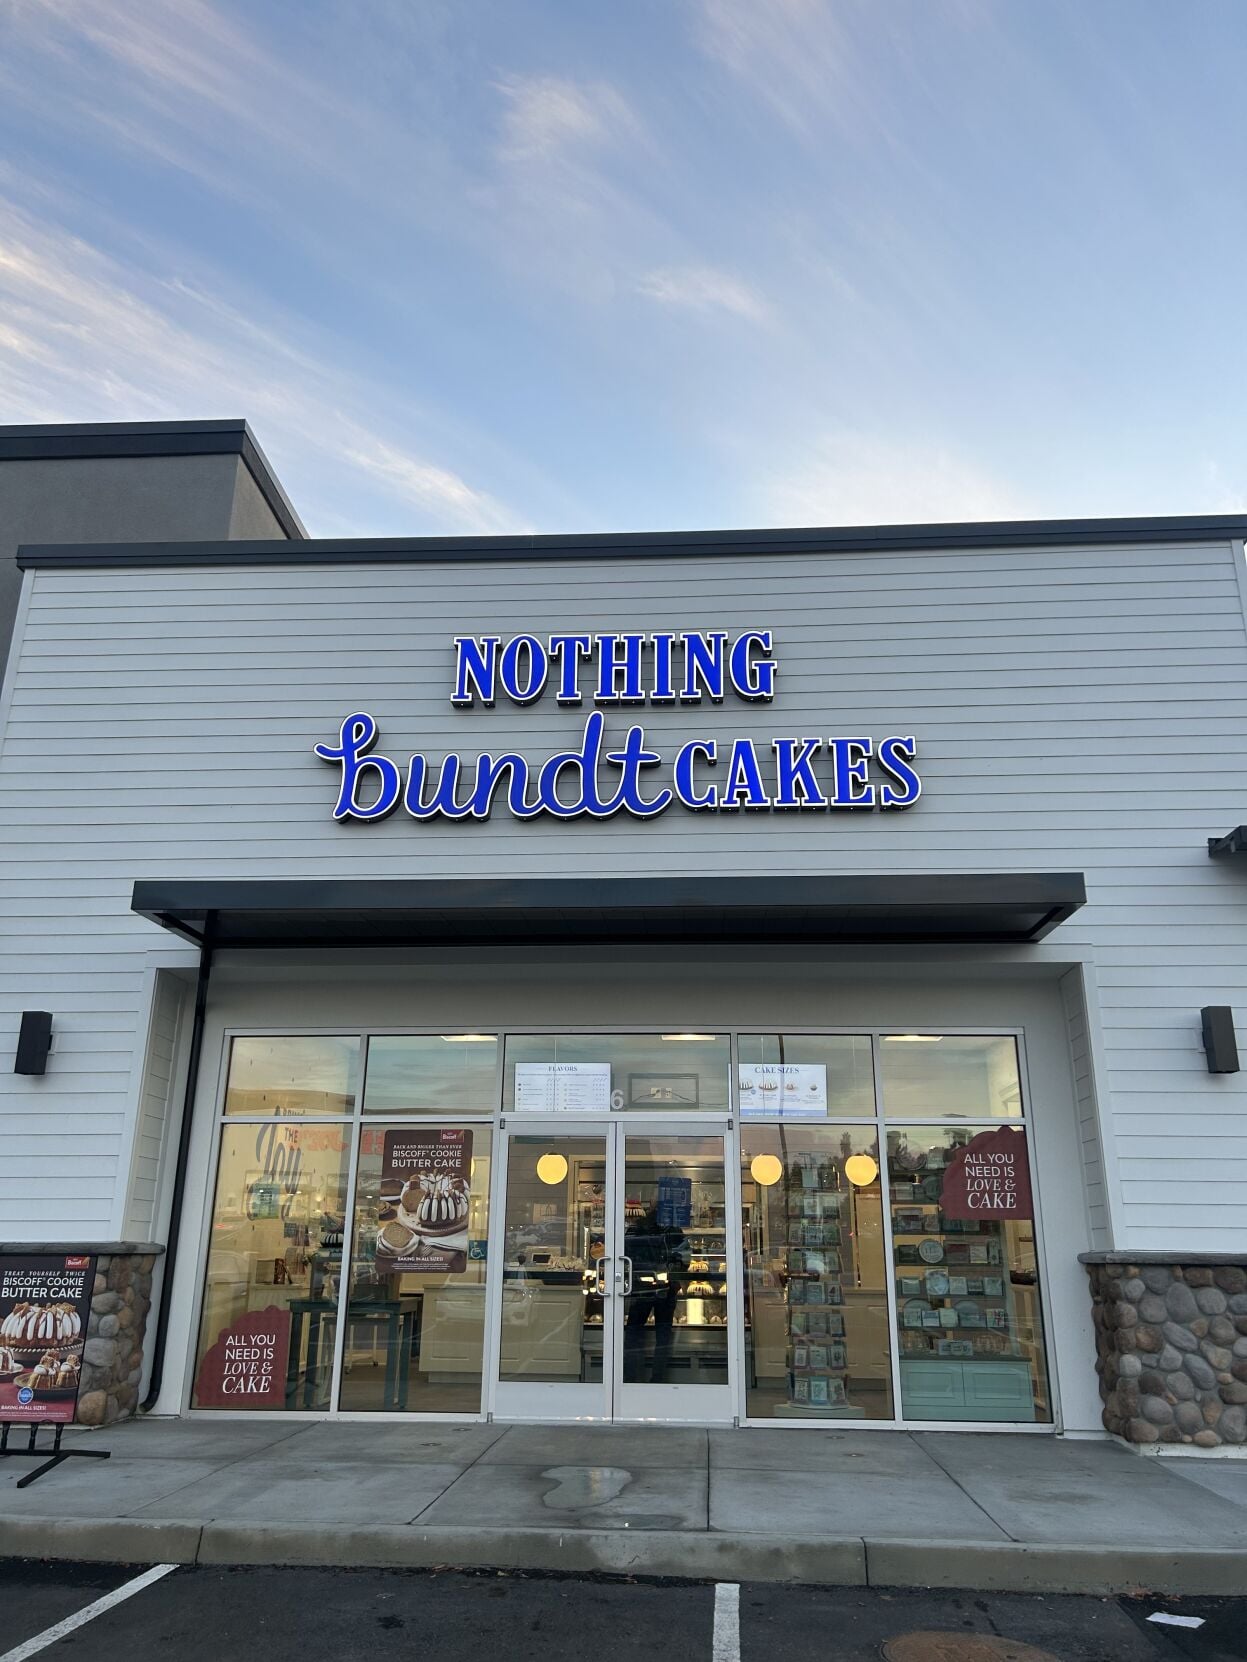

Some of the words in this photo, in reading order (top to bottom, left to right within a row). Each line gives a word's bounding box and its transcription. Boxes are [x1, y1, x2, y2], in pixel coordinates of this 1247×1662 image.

[450, 630, 778, 704] NOTHING
[314, 710, 672, 821] bundt
[673, 735, 923, 809] CAKES
[754, 1066, 776, 1074] CAKE
[777, 1066, 800, 1074] SIZES
[610, 1089, 624, 1110] 6
[284, 1126, 299, 1143] THE
[391, 1159, 431, 1168] BUTTER
[434, 1159, 462, 1168] CAKE
[964, 1153, 986, 1164] ALL
[987, 1153, 1014, 1164] YOU
[965, 1166, 1001, 1177] NEED
[1004, 1166, 1015, 1177] IS
[966, 1178, 1002, 1191] LOVE
[1005, 1178, 1016, 1191] &
[967, 1192, 1017, 1209] CAKE
[47, 1277, 84, 1286] COOKIE
[1, 1287, 47, 1298] BUTTER
[50, 1287, 83, 1298] CAKE
[225, 1335, 247, 1346] ALL
[250, 1334, 276, 1346] YOU
[225, 1348, 260, 1360] NEED
[263, 1348, 274, 1359] IS
[223, 1361, 259, 1375] LOVE
[261, 1361, 273, 1375] &
[222, 1375, 272, 1394] CAKE
